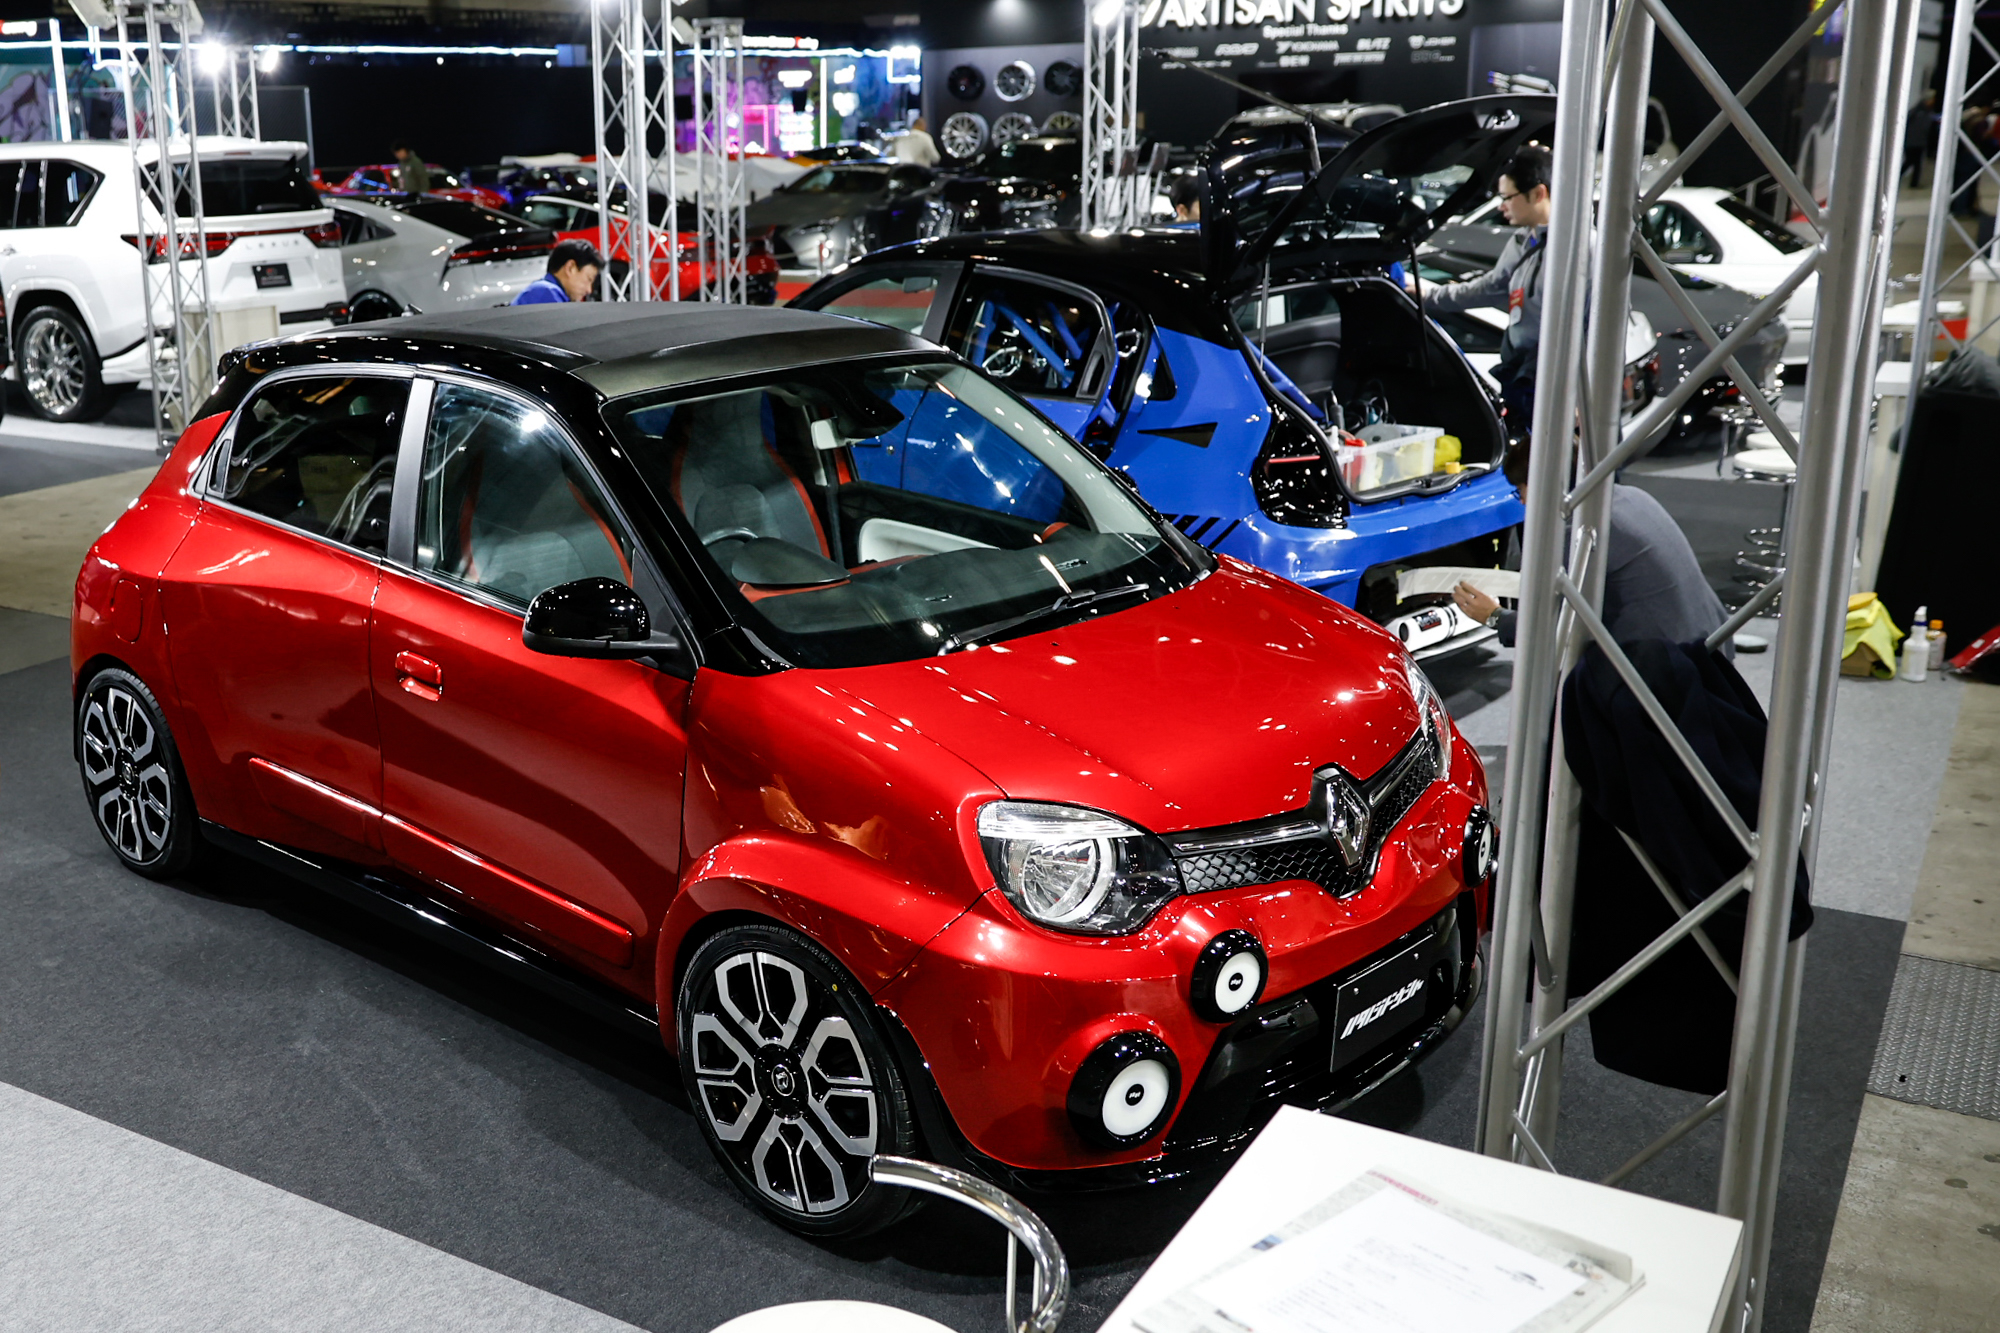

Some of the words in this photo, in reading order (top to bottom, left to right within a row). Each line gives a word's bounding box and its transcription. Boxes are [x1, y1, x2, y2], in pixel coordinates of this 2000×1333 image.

[1157, 0, 1316, 28] ARTISAN
[1262, 25, 1305, 40] Special
[1306, 23, 1349, 36] Thanks
